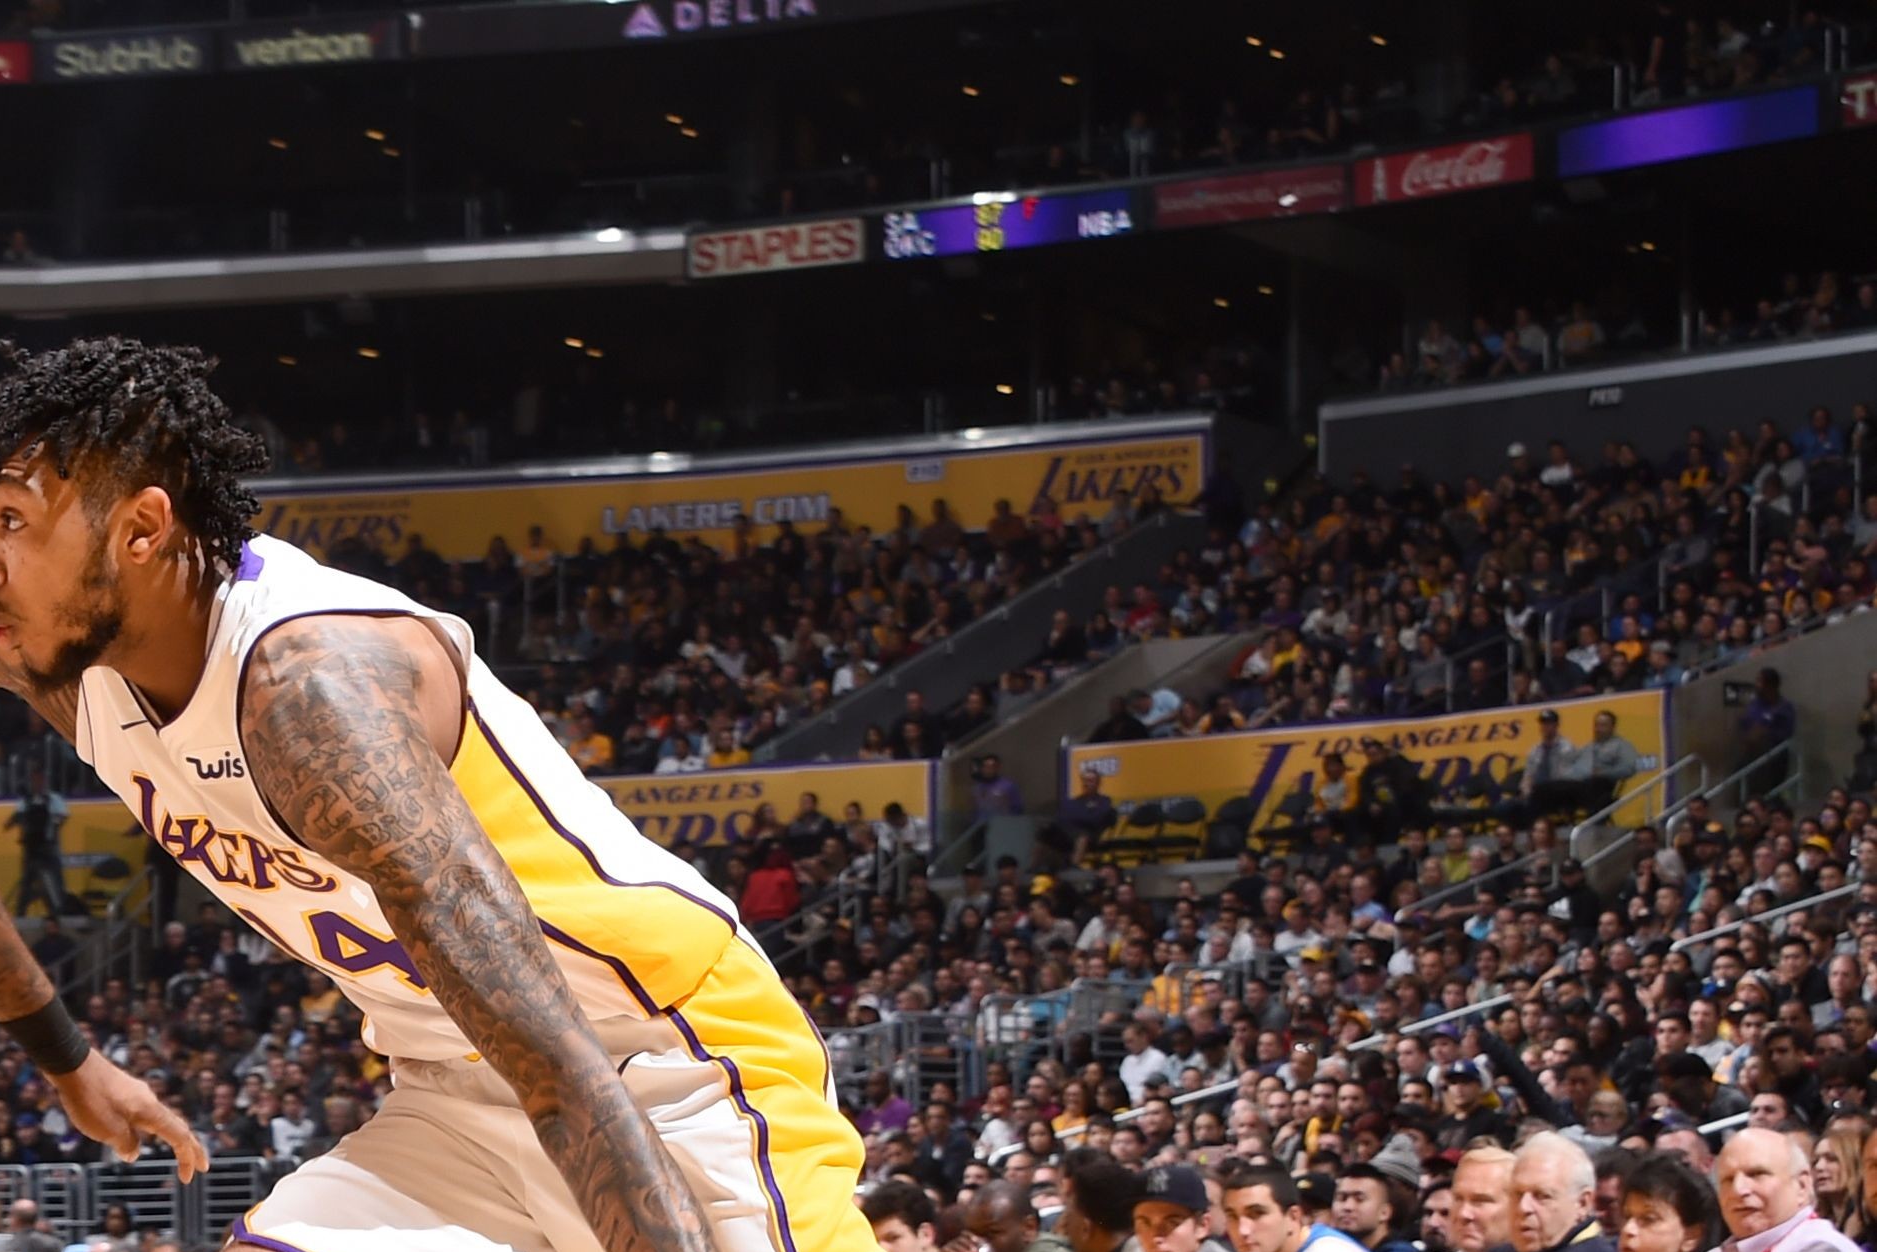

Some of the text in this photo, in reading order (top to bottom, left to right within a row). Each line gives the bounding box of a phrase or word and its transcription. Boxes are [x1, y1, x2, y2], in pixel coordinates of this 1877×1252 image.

[673, 0, 818, 32] DELTA
[55, 37, 202, 77] StubHub
[237, 31, 371, 67] verizon
[1078, 210, 1133, 237] NBA
[693, 223, 860, 274] STAPLES
[185, 751, 245, 780] wis
